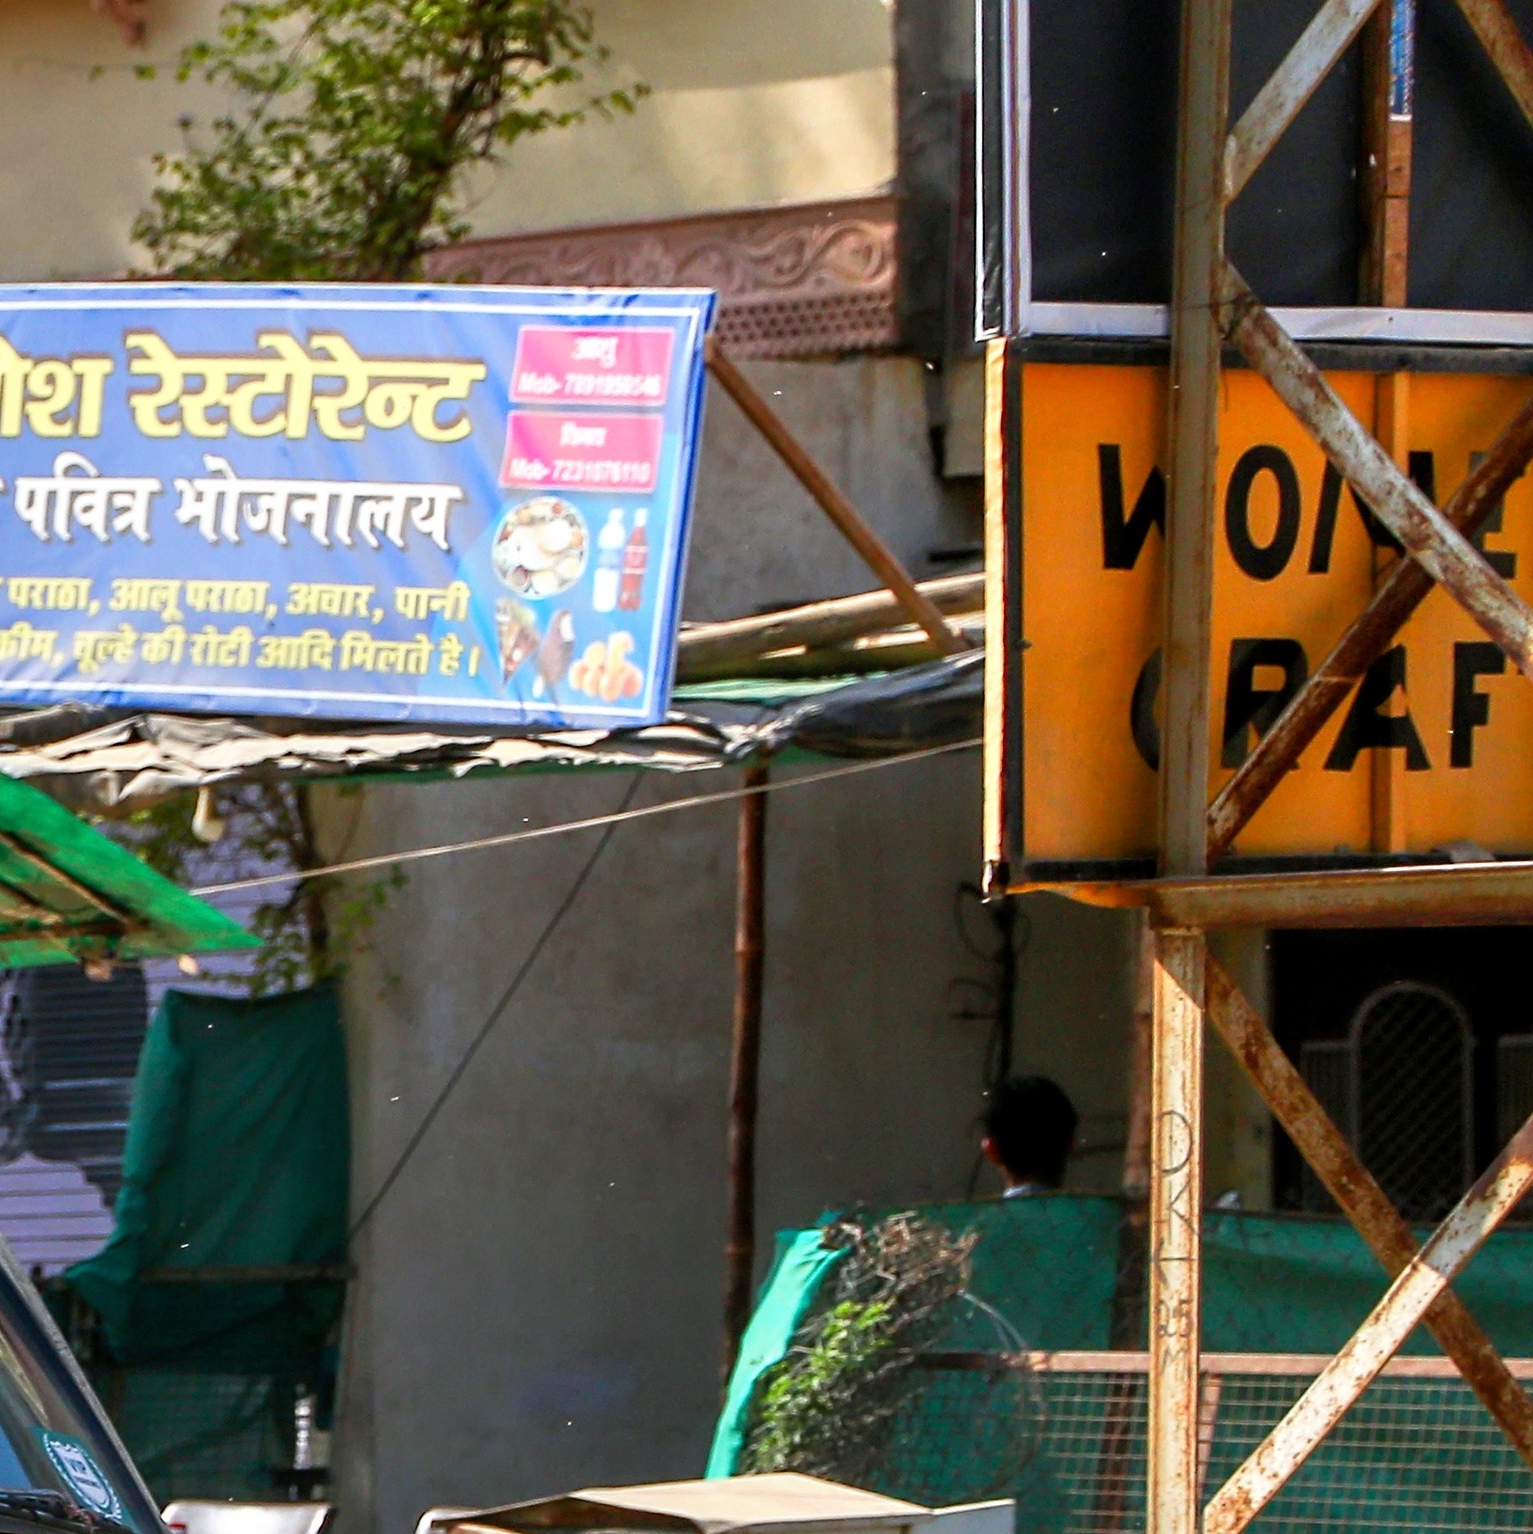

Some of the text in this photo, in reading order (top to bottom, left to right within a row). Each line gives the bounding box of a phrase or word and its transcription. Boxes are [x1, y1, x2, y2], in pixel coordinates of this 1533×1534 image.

[124, 330, 487, 443] रेस्टोरेन्ट
[14, 451, 162, 543] पवित्र
[174, 452, 463, 553] भोजनालय
[108, 578, 185, 623] आलू
[395, 580, 471, 622] पानी
[140, 624, 188, 665] की
[188, 624, 255, 668] रोटी
[256, 628, 336, 670] आदि
[338, 630, 433, 676] मिलते
